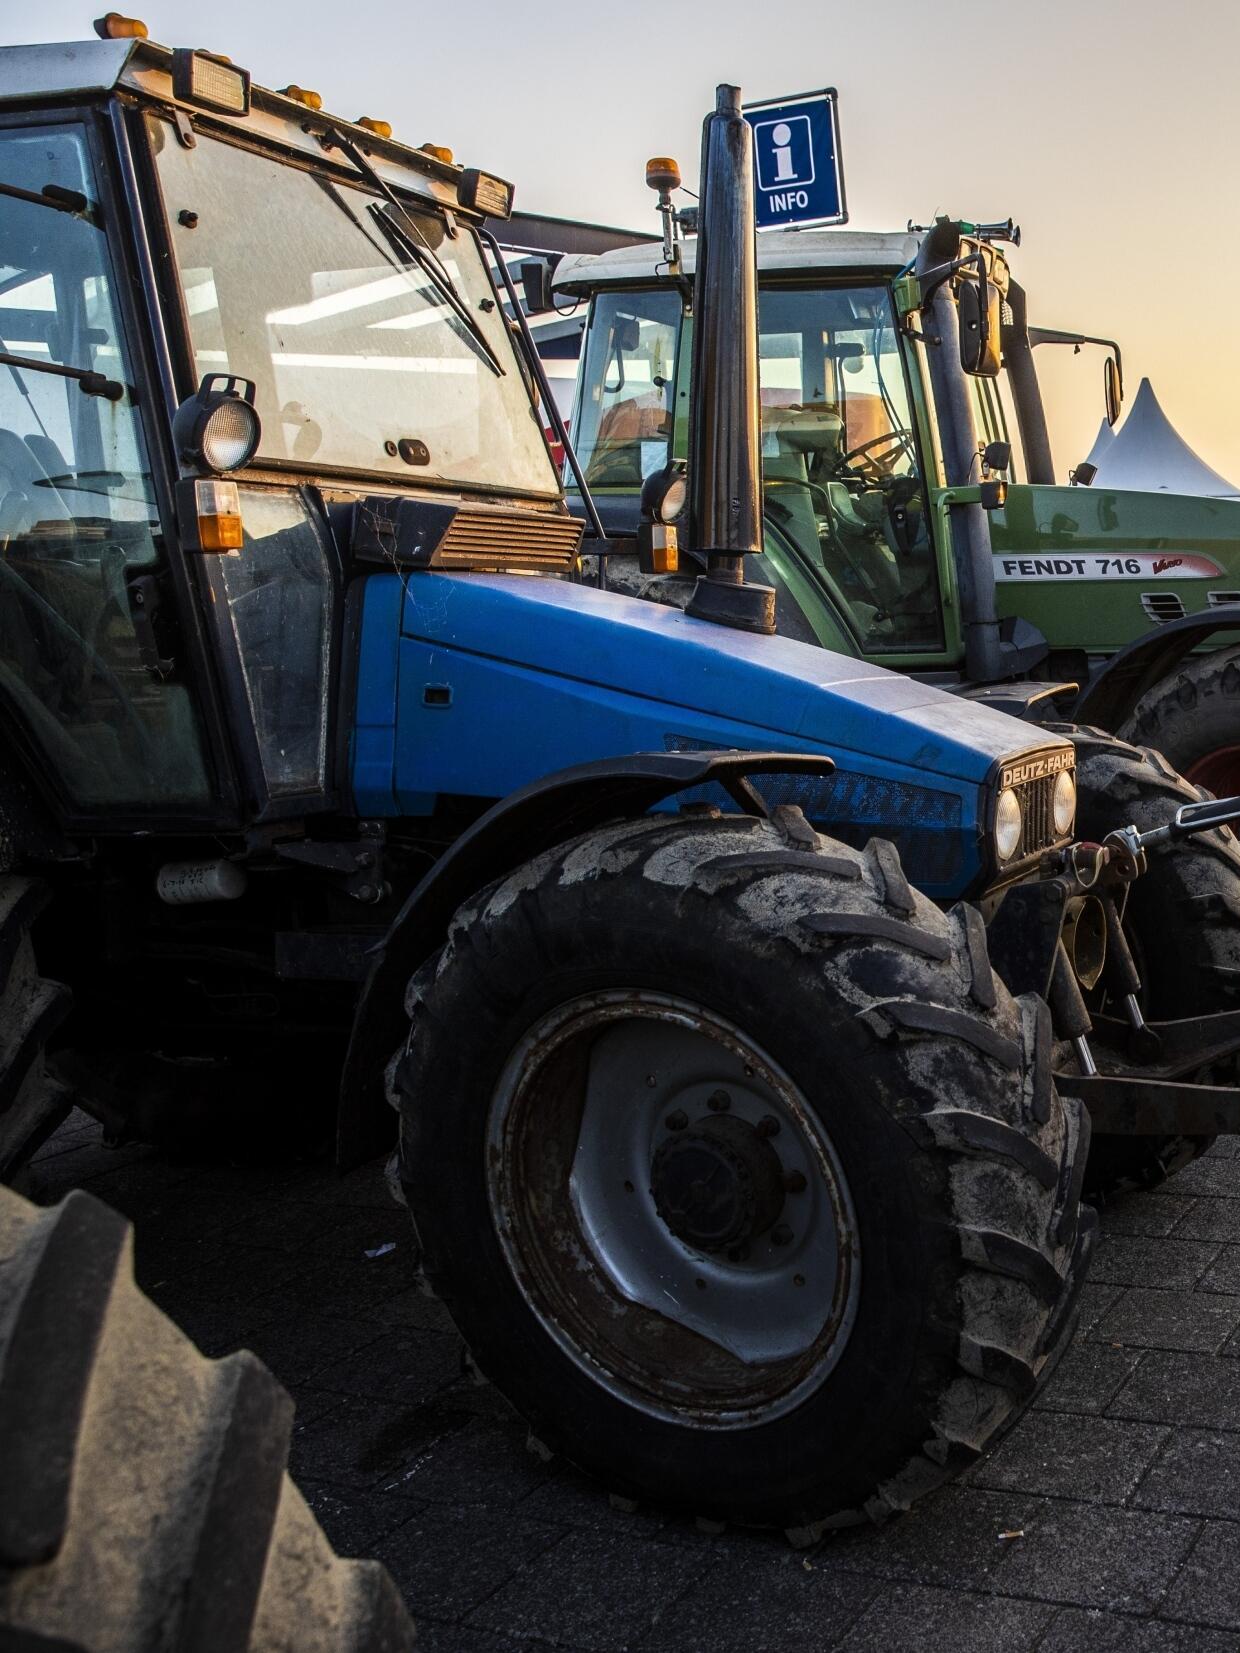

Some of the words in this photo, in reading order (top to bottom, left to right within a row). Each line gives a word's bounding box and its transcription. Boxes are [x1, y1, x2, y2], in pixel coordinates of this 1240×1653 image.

[769, 190, 809, 213] INFO
[1002, 559, 1086, 576] FENDT
[1095, 558, 1141, 575] 716
